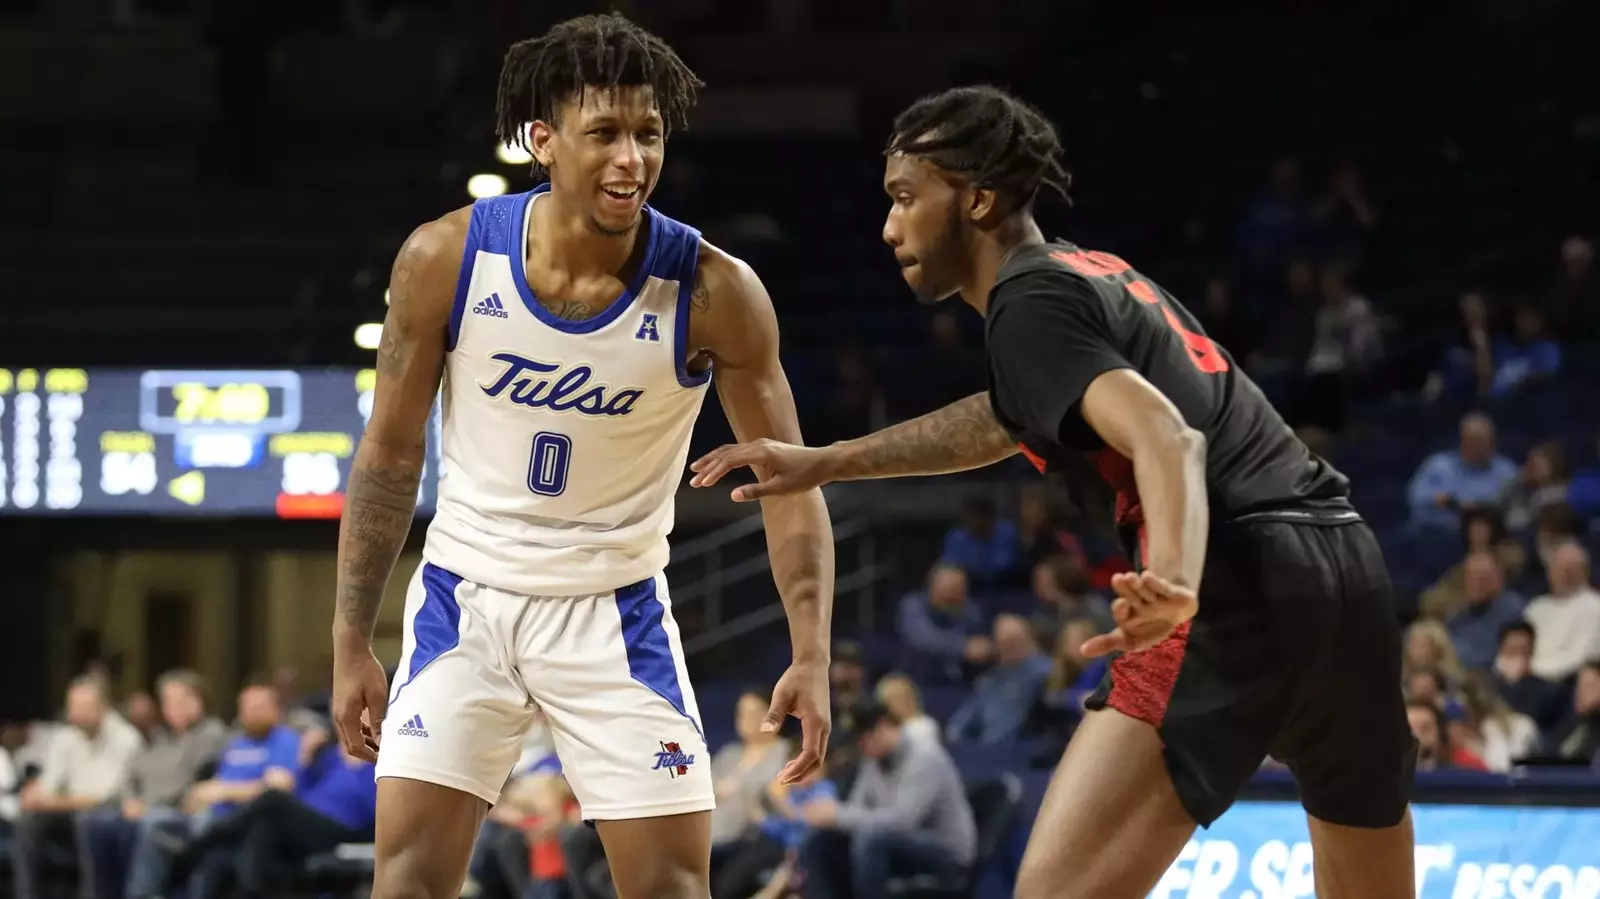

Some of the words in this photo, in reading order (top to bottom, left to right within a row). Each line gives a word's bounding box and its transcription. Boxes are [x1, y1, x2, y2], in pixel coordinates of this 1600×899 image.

[473, 305, 509, 319] adidas
[479, 353, 646, 416] Tulsa
[527, 431, 573, 497] 0
[397, 727, 429, 739] adidas
[651, 750, 695, 770] Tulsa
